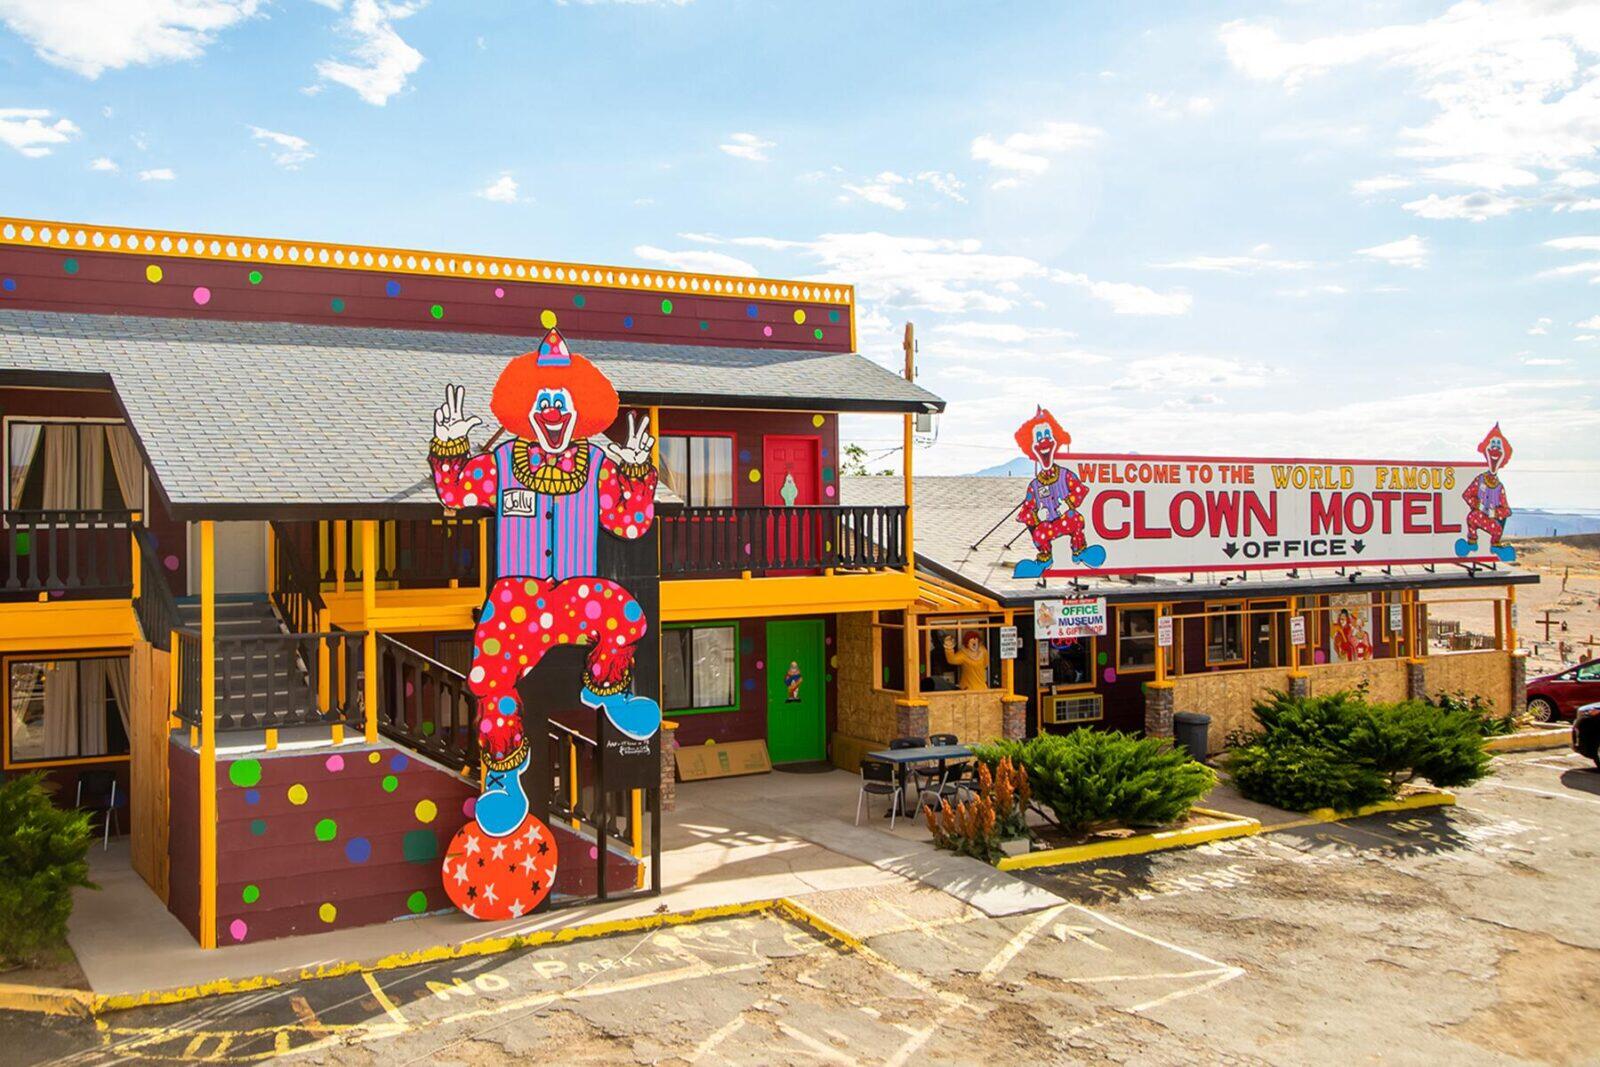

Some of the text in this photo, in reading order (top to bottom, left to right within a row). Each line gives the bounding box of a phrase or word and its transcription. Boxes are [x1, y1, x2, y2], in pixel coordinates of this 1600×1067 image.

[1078, 463, 1456, 490] WELCOME TO THE WORLD FAMOUS
[504, 490, 533, 513] Jolly
[1091, 489, 1462, 541] CLOWN MOTEL
[1242, 539, 1347, 559] OFFICE
[1058, 615, 1104, 627] MUSEUM
[1061, 605, 1099, 616] OFFICE
[1058, 628, 1064, 636] &
[1066, 626, 1083, 636] GIFT
[425, 973, 510, 1000] NO
